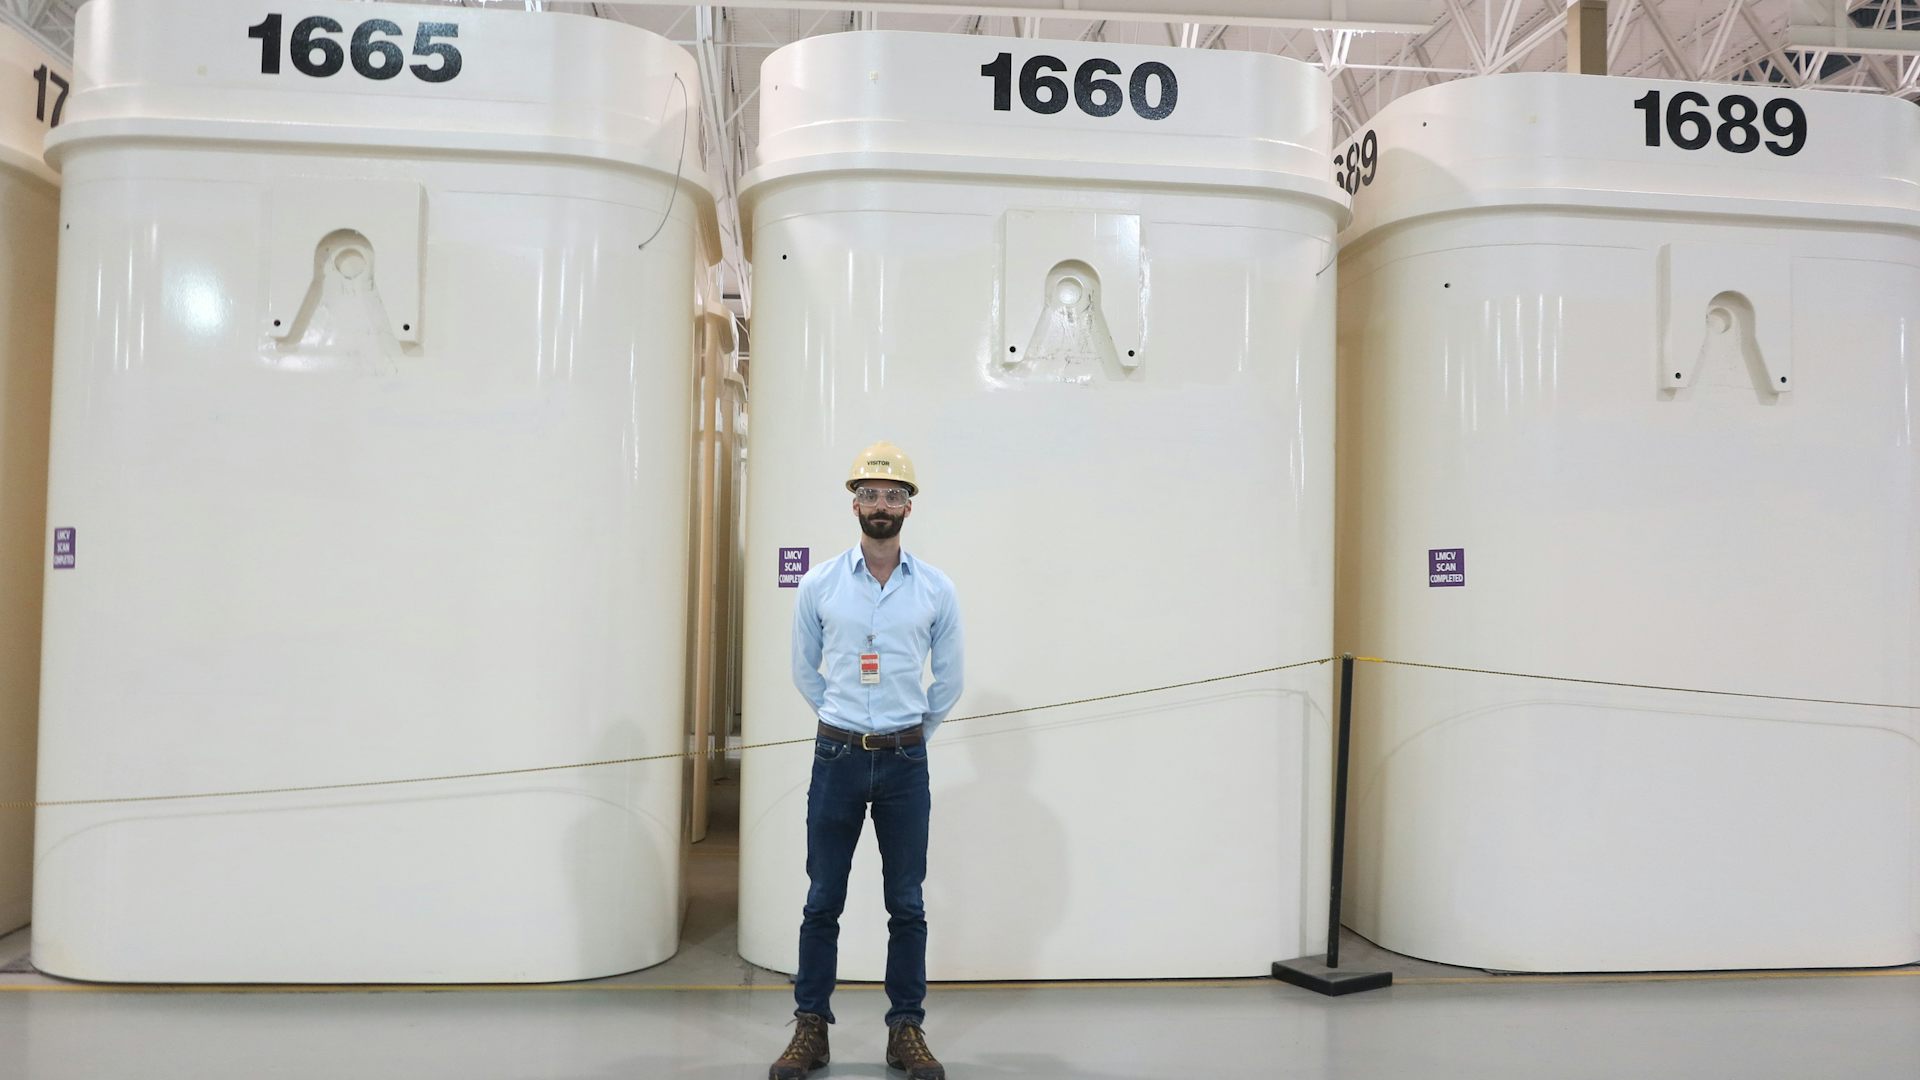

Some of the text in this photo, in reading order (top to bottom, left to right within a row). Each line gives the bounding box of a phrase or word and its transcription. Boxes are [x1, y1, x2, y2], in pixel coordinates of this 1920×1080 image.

[248, 13, 463, 84] 1665
[980, 52, 1178, 121] 1660
[1633, 89, 1808, 157] 1689
[57, 530, 71, 541] LMCV
[57, 542, 70, 553] SCAN
[784, 550, 802, 560] LMCV
[1435, 551, 1457, 561] LMCV
[784, 562, 802, 572] SCAN
[1436, 562, 1457, 572] SCAN
[1430, 573, 1464, 583] COMPLETED
